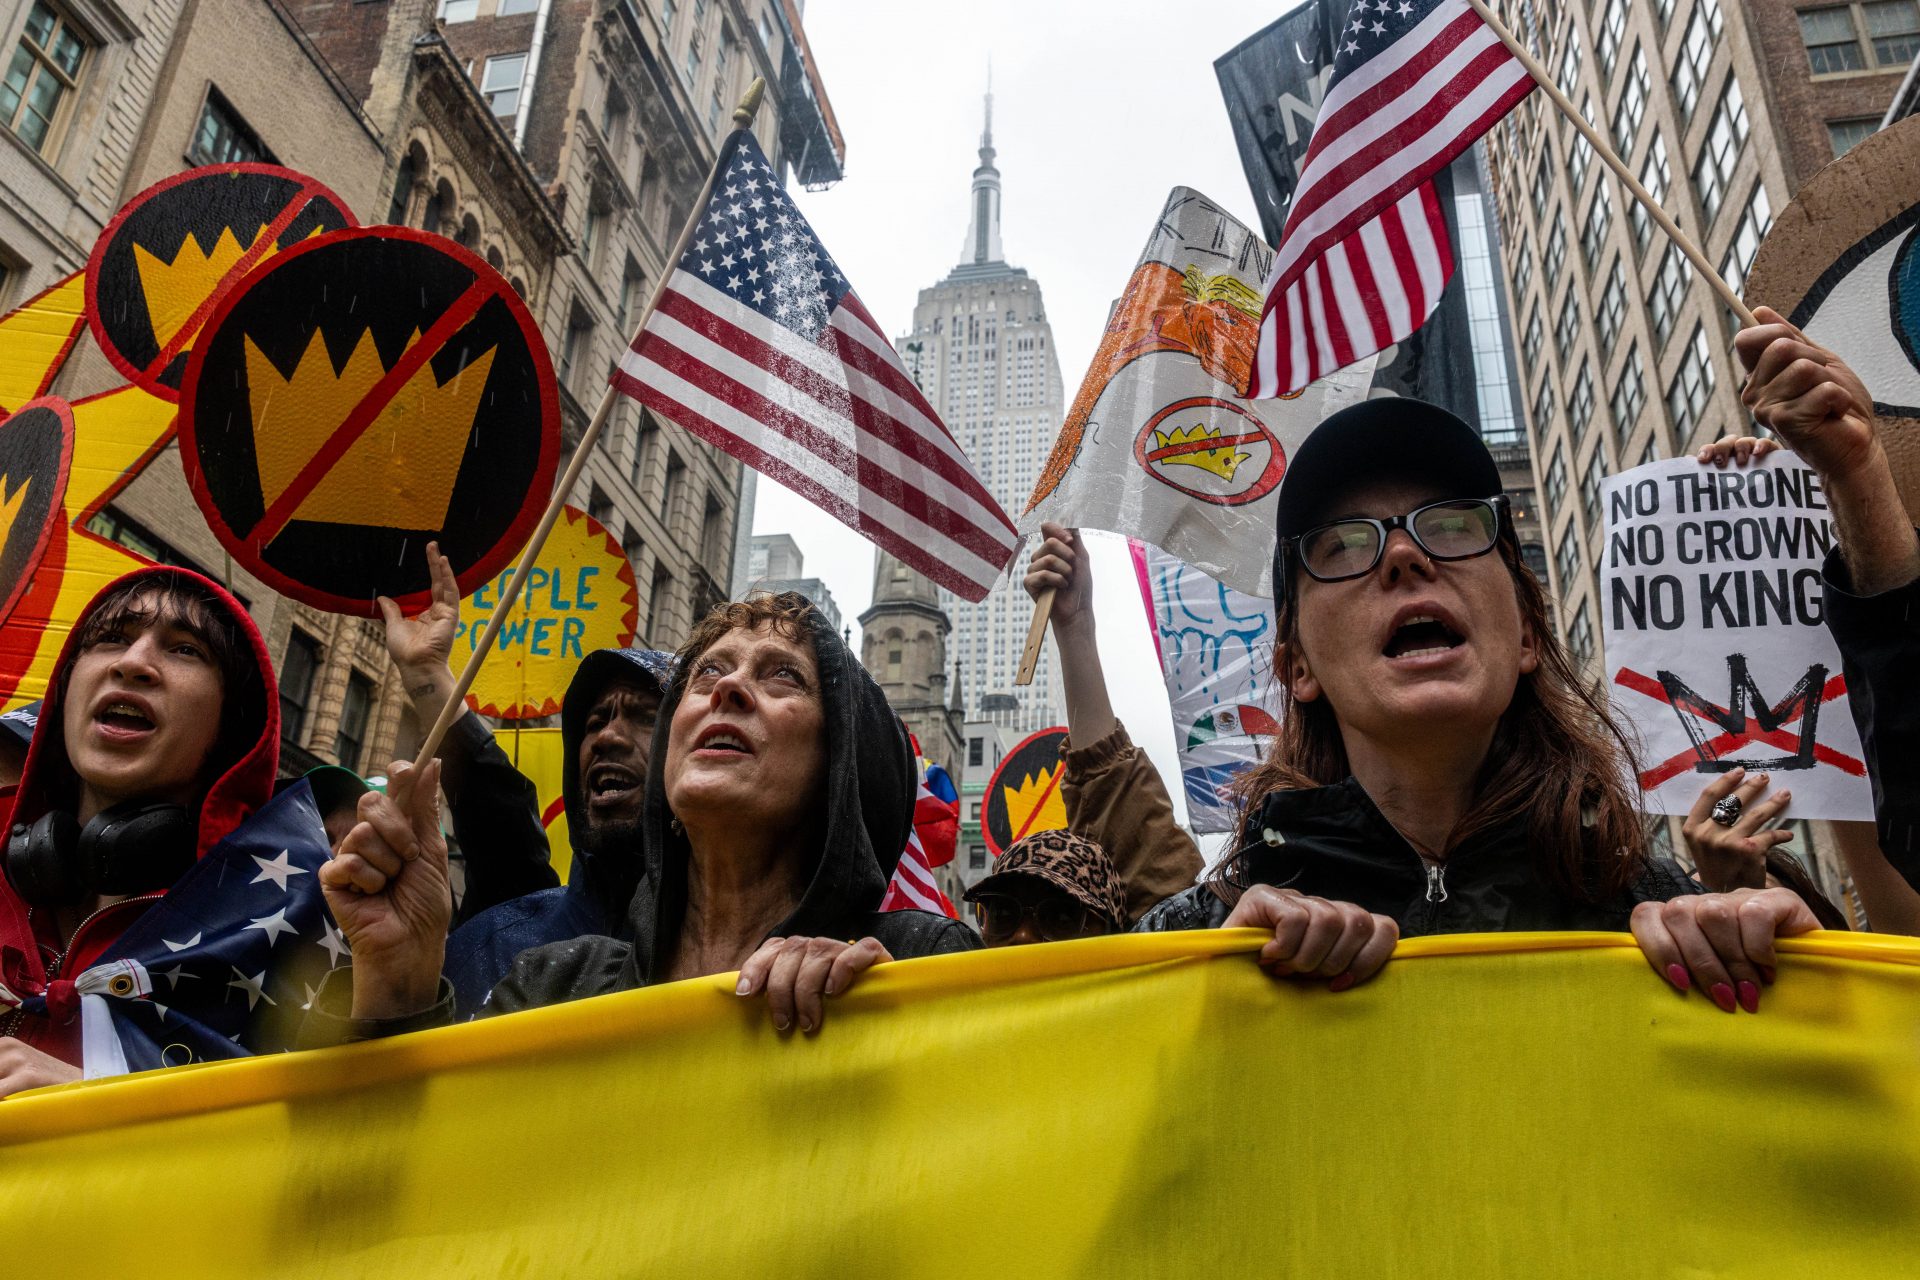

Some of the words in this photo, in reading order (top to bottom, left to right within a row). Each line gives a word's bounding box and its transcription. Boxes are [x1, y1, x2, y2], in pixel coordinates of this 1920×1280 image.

[1610, 479, 1659, 526] NO
[1667, 468, 1827, 513] THRONE
[1610, 524, 1664, 568] NO
[1676, 517, 1838, 564] CROWN
[473, 566, 599, 611] EOPLE
[1611, 575, 1684, 631] NO
[1700, 568, 1825, 628] KING
